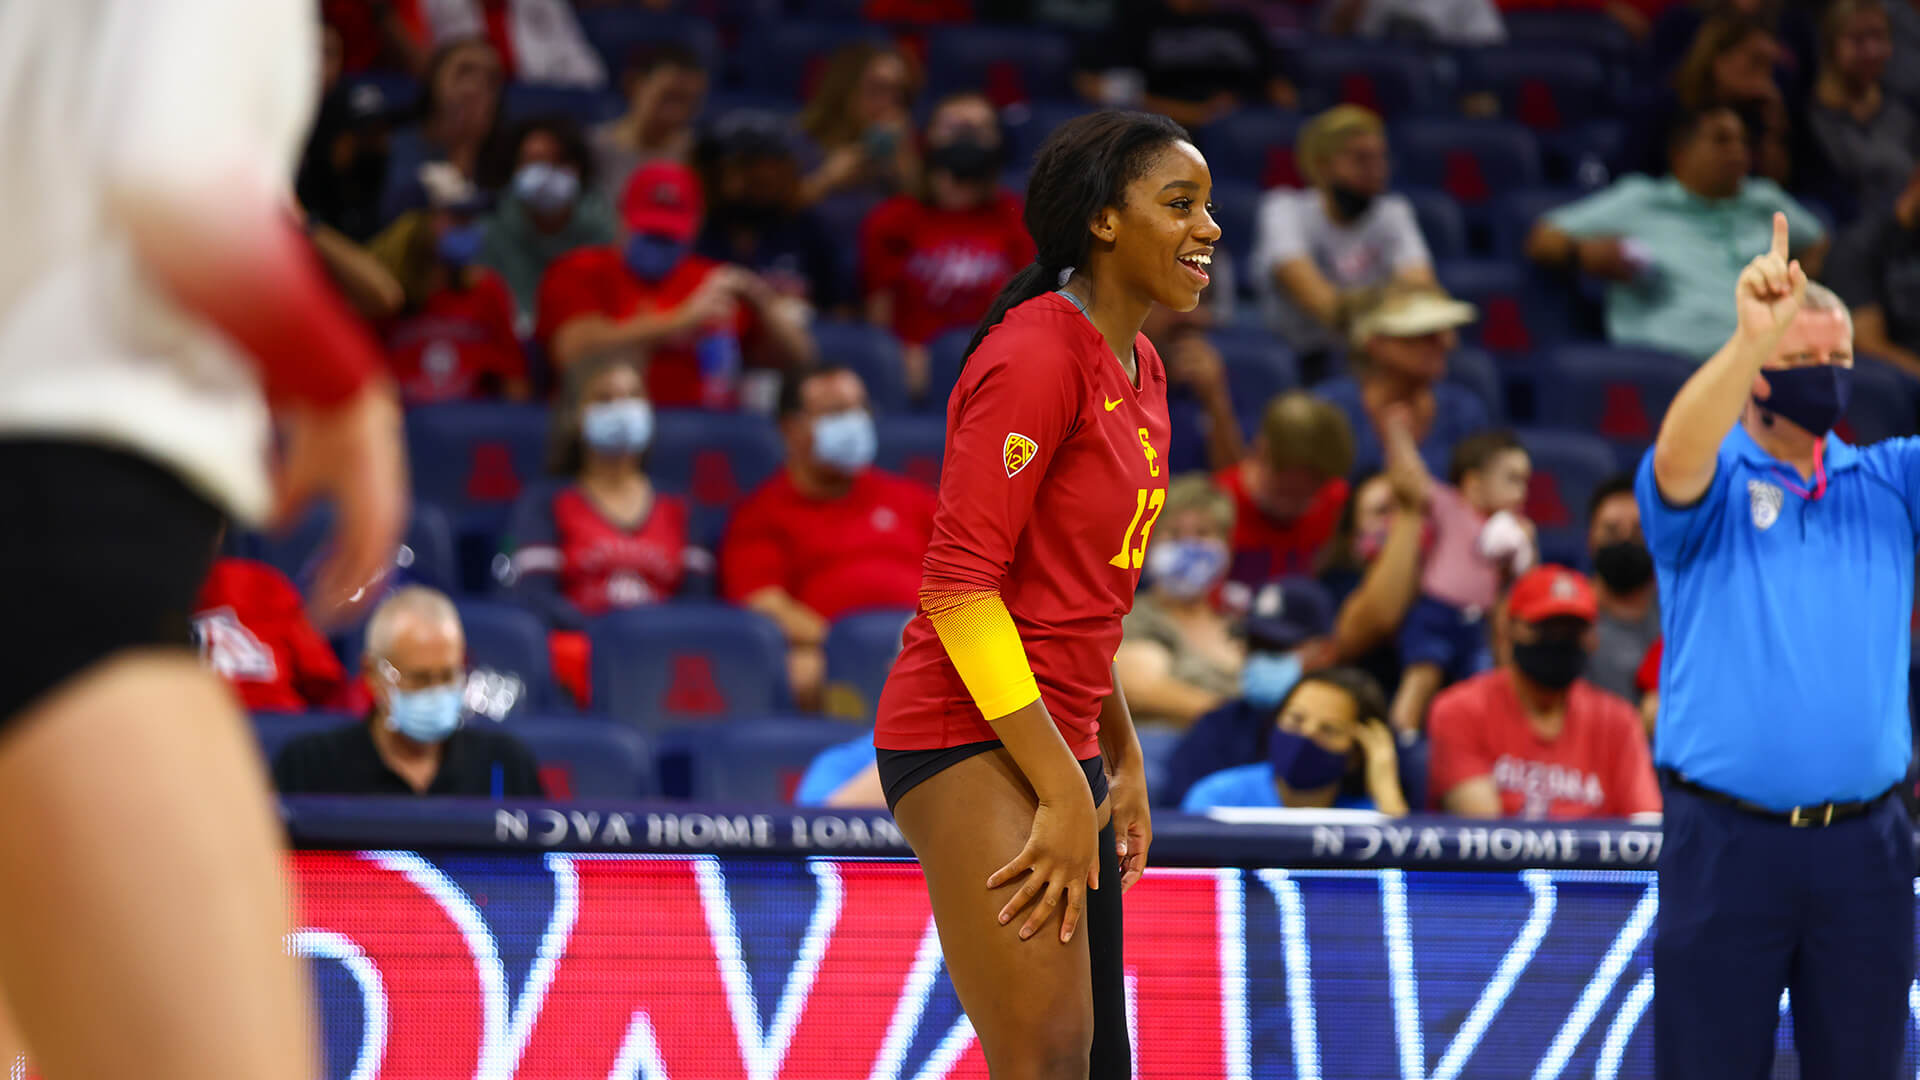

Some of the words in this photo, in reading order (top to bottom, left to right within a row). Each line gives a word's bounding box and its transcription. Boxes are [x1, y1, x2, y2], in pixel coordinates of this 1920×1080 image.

[1006, 435, 1036, 465] PAC
[1007, 453, 1022, 470] 12
[1108, 488, 1166, 569] 13
[646, 812, 776, 848] HOME
[1457, 827, 1579, 862] HOME
